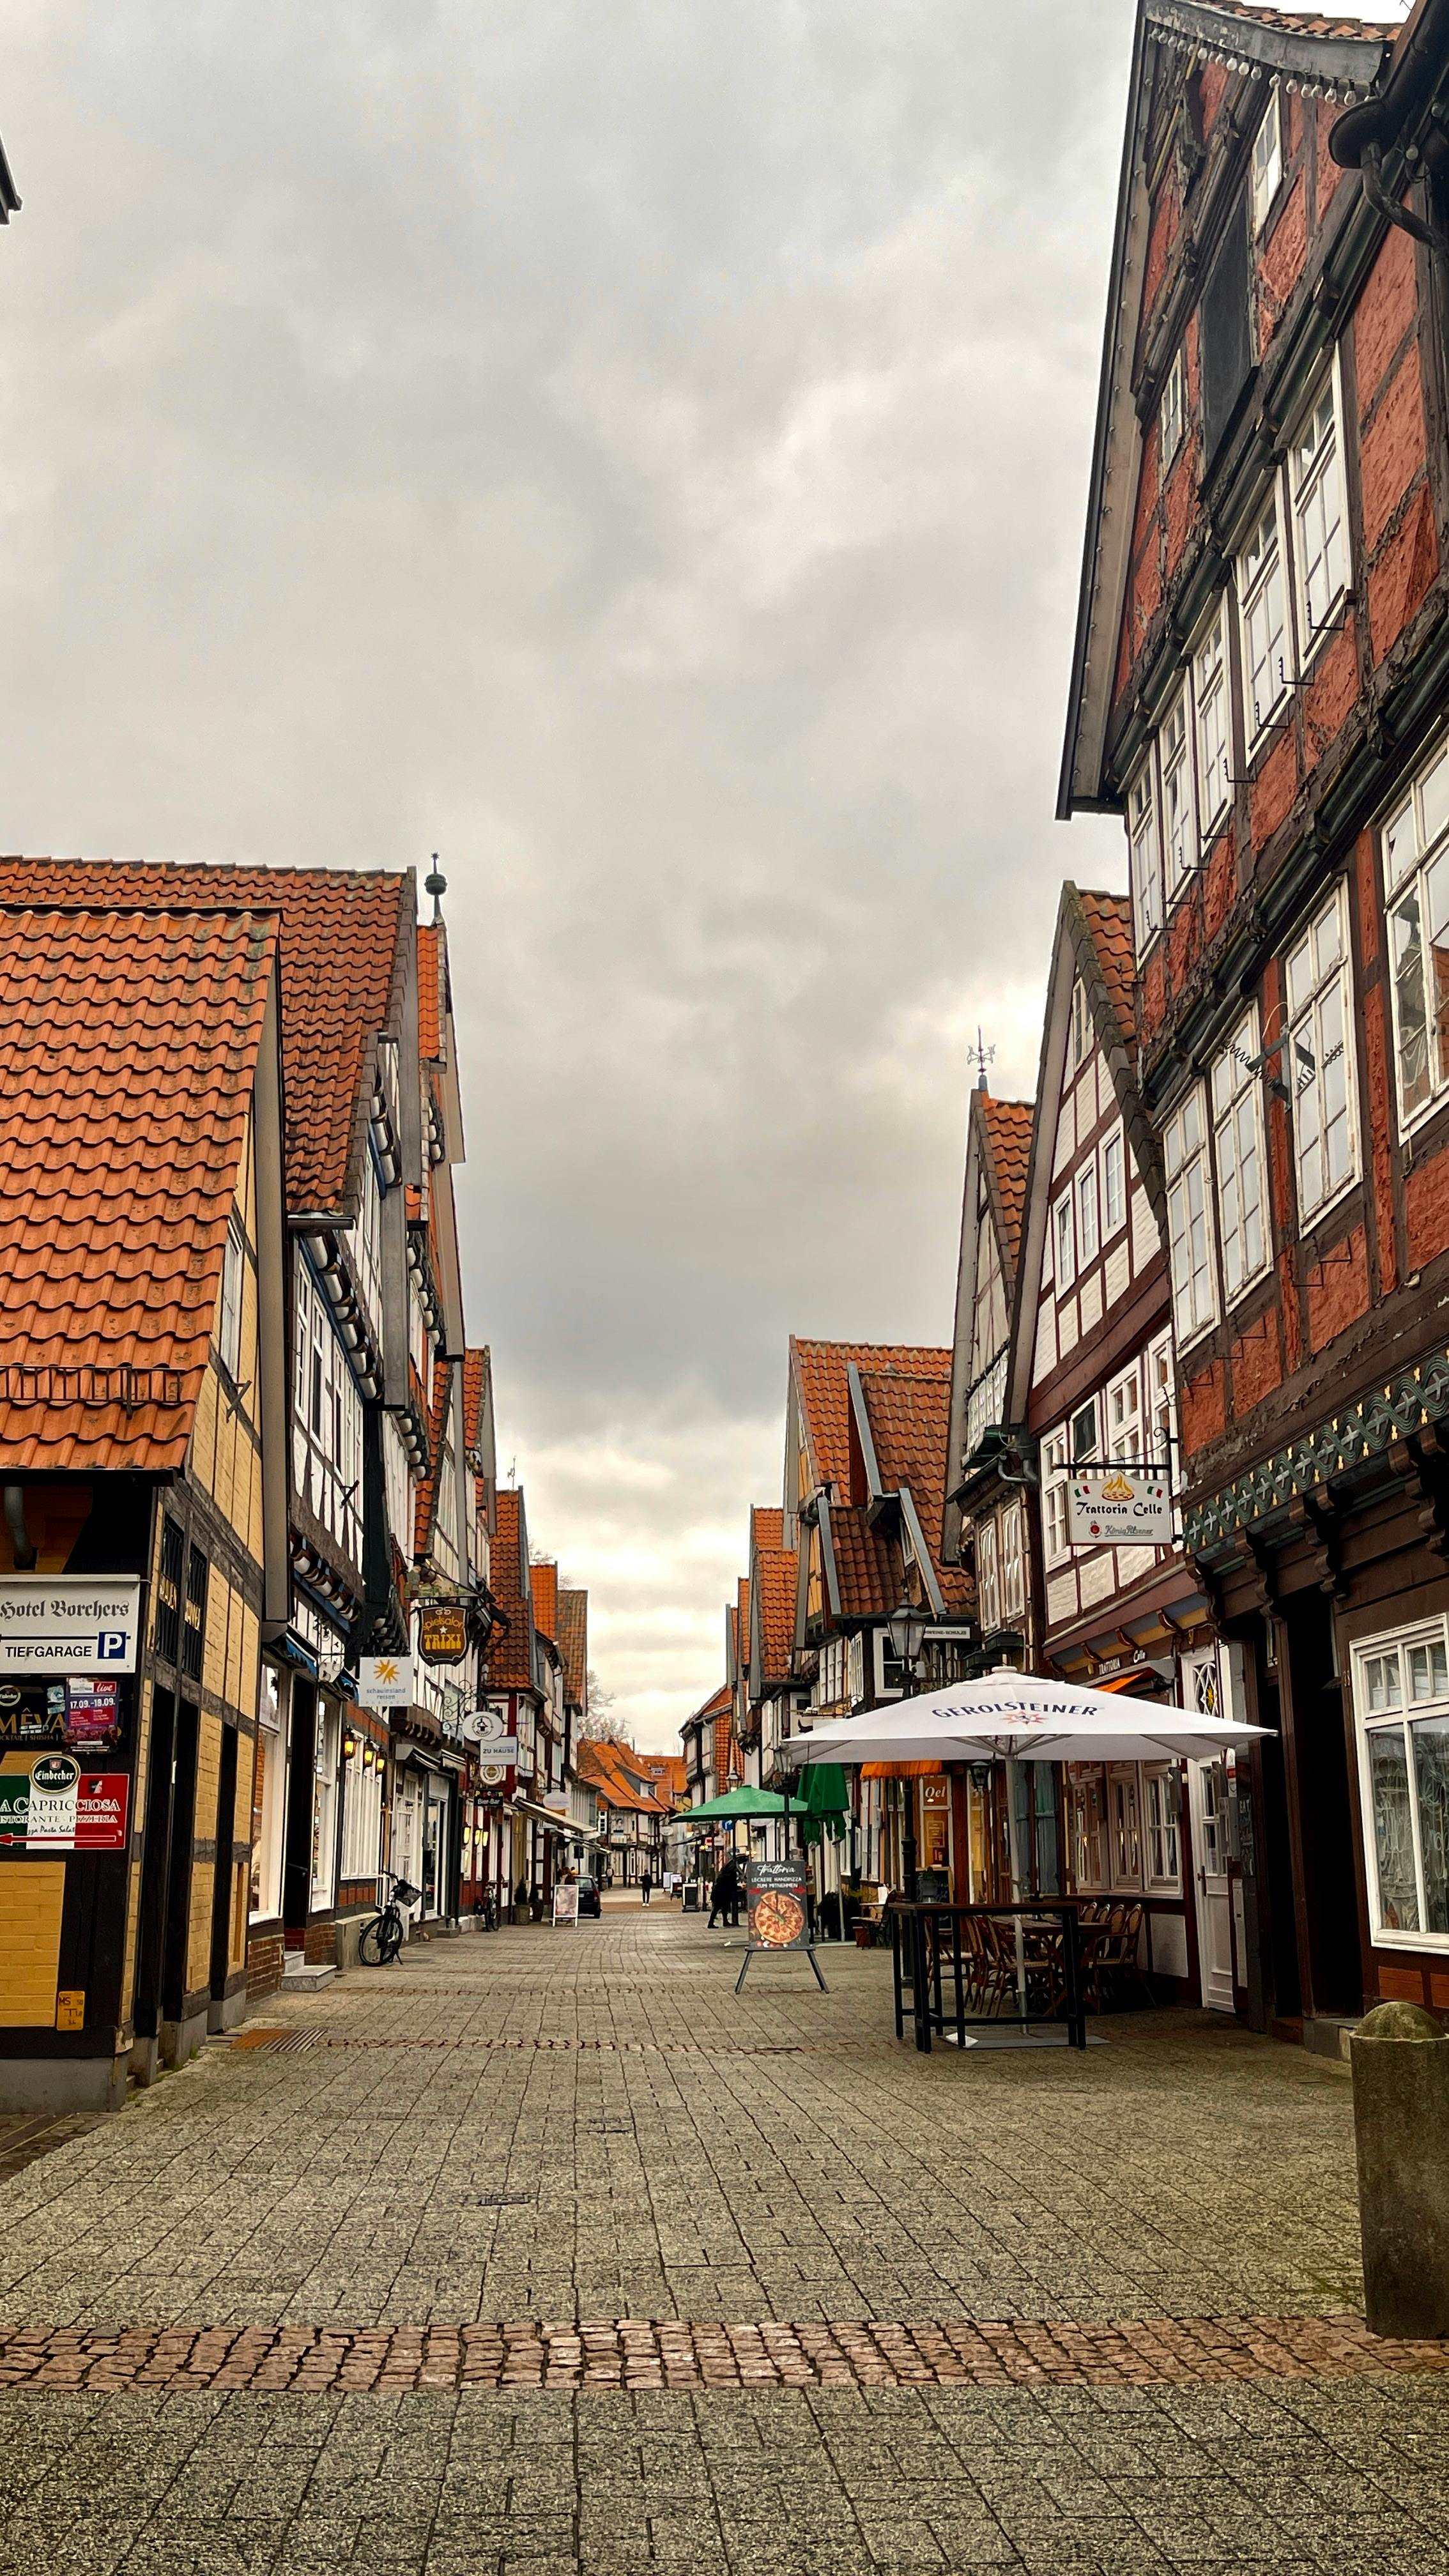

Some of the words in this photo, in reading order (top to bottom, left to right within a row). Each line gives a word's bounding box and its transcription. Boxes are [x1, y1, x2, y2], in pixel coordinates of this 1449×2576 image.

[1076, 1501, 1127, 1515] Trattoria
[1133, 1502, 1162, 1516] Celle
[0, 1600, 46, 1623] Hotel
[50, 1600, 130, 1621] Borchers
[5, 1646, 92, 1657] TIEFGARAGE
[103, 1633, 123, 1658] P
[424, 1634, 461, 1650] TRIXI
[96, 1682, 113, 1692] live
[931, 1701, 1099, 1719] GEROLSTEINER
[40, 1825, 57, 1833] Pasta
